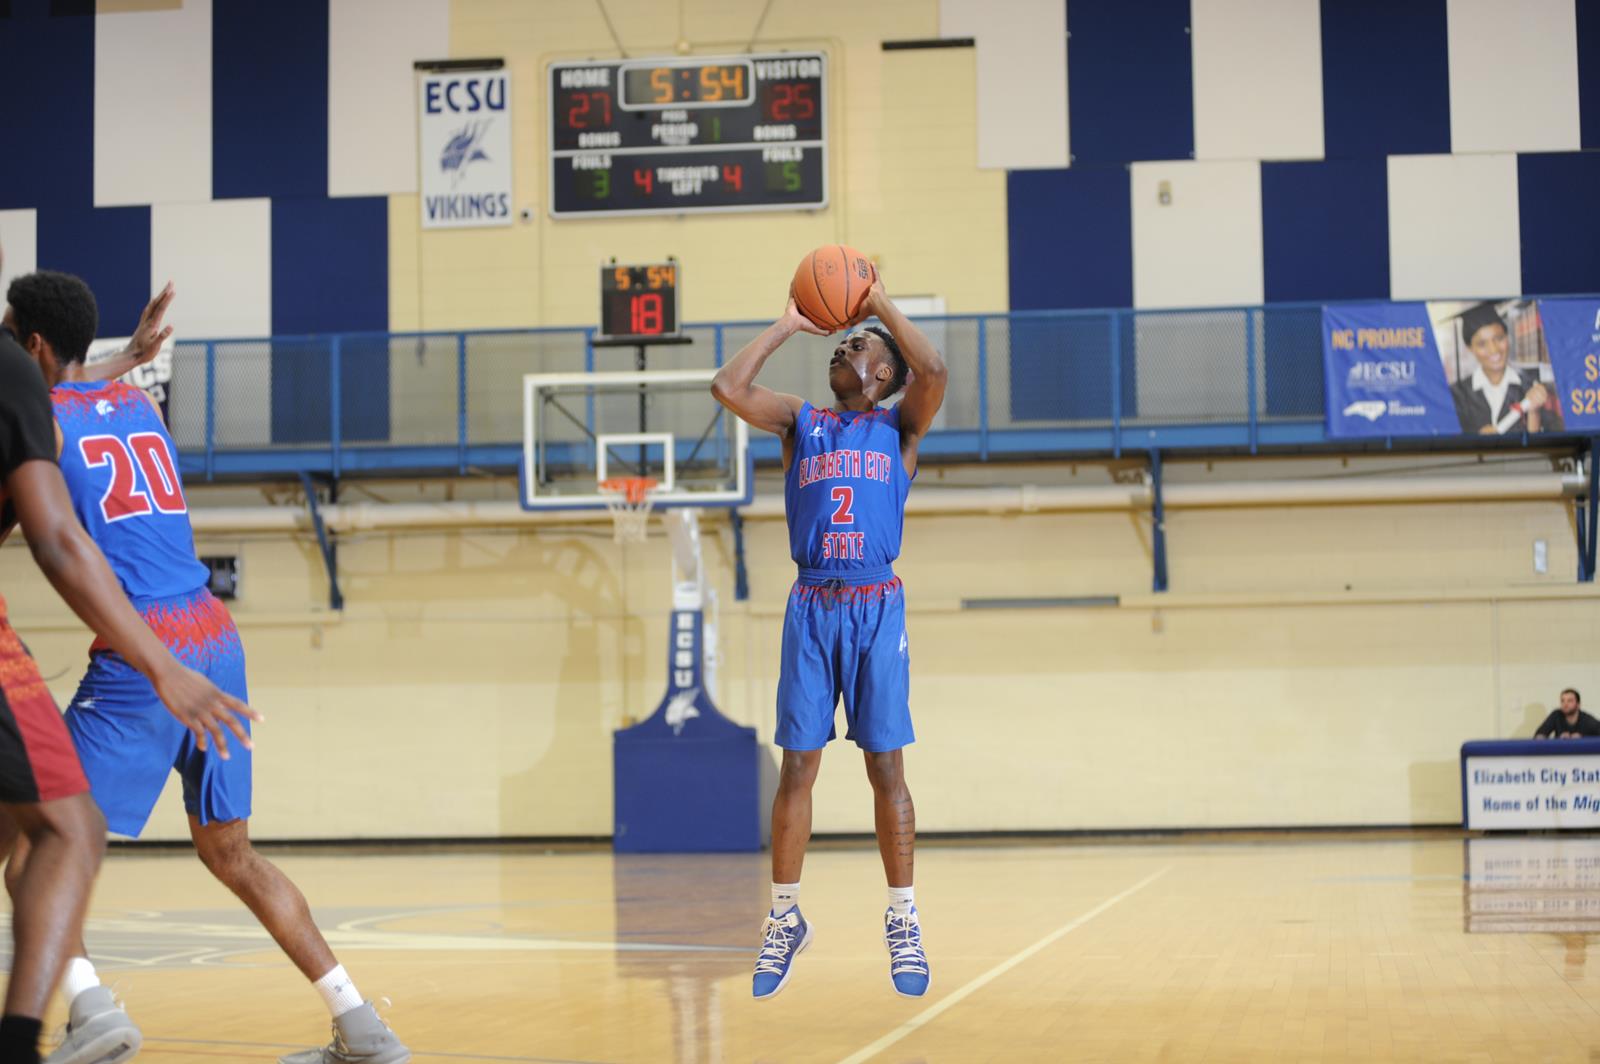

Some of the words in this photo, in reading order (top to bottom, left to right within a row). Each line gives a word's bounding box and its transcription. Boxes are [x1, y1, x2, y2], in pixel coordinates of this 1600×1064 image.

[560, 68, 611, 88] HOME
[755, 59, 821, 80] VISITOR
[426, 78, 505, 113] ECSU
[770, 83, 814, 121] 25
[568, 92, 612, 128] 27
[578, 132, 621, 148] BONUS
[651, 122, 698, 139] PERIOD
[753, 125, 797, 141] BONUS
[572, 154, 612, 170] FOULS
[762, 146, 803, 162] FOULS
[594, 169, 609, 198] 3
[633, 168, 652, 194] 4
[671, 180, 702, 195] LEFT
[723, 164, 743, 192] 4
[783, 161, 801, 191] 5
[426, 193, 508, 219] VIKINGS
[630, 293, 663, 335] 18
[1332, 330, 1354, 348] NC
[1357, 327, 1425, 349] PROMISE
[78, 432, 187, 524] 20
[800, 449, 861, 489] ELIZABETH
[865, 451, 891, 484] CITY
[831, 486, 854, 525] 2
[822, 532, 864, 560] STATE
[1474, 769, 1535, 785] Elizabeth
[1541, 769, 1567, 787] City
[1483, 796, 1521, 812] Home
[1526, 796, 1539, 811] of
[1545, 796, 1567, 811] the
